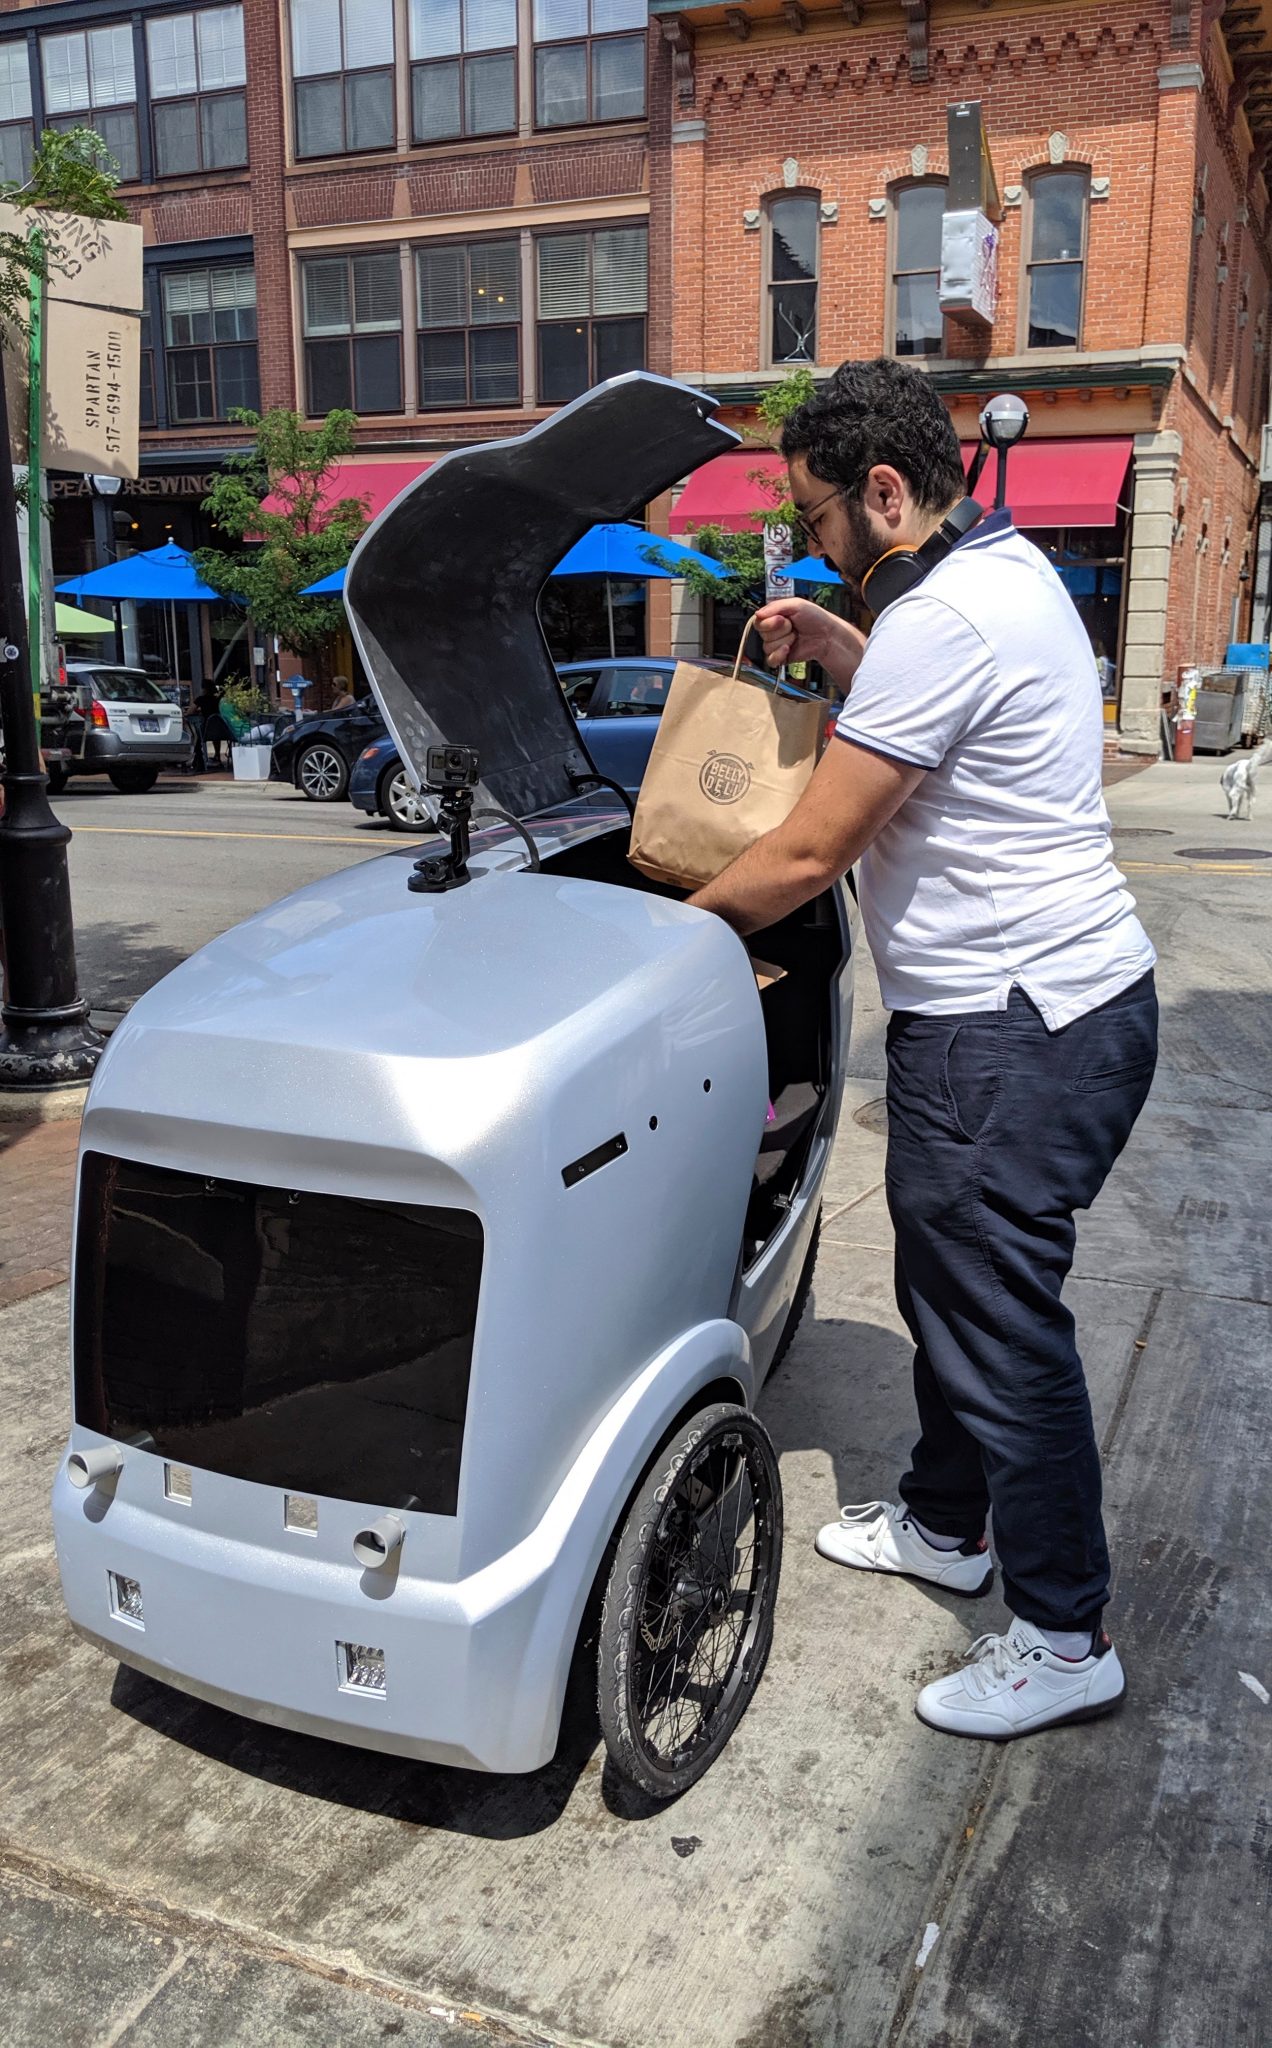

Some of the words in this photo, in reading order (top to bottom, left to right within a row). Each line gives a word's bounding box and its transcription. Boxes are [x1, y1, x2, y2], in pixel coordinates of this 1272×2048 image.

[86, 349, 101, 428] SPARTAN
[106, 330, 122, 453] 517-694-1500
[50, 479, 96, 499] PEA
[709, 761, 745, 783] BELLY
[706, 775, 740, 797] DELI
